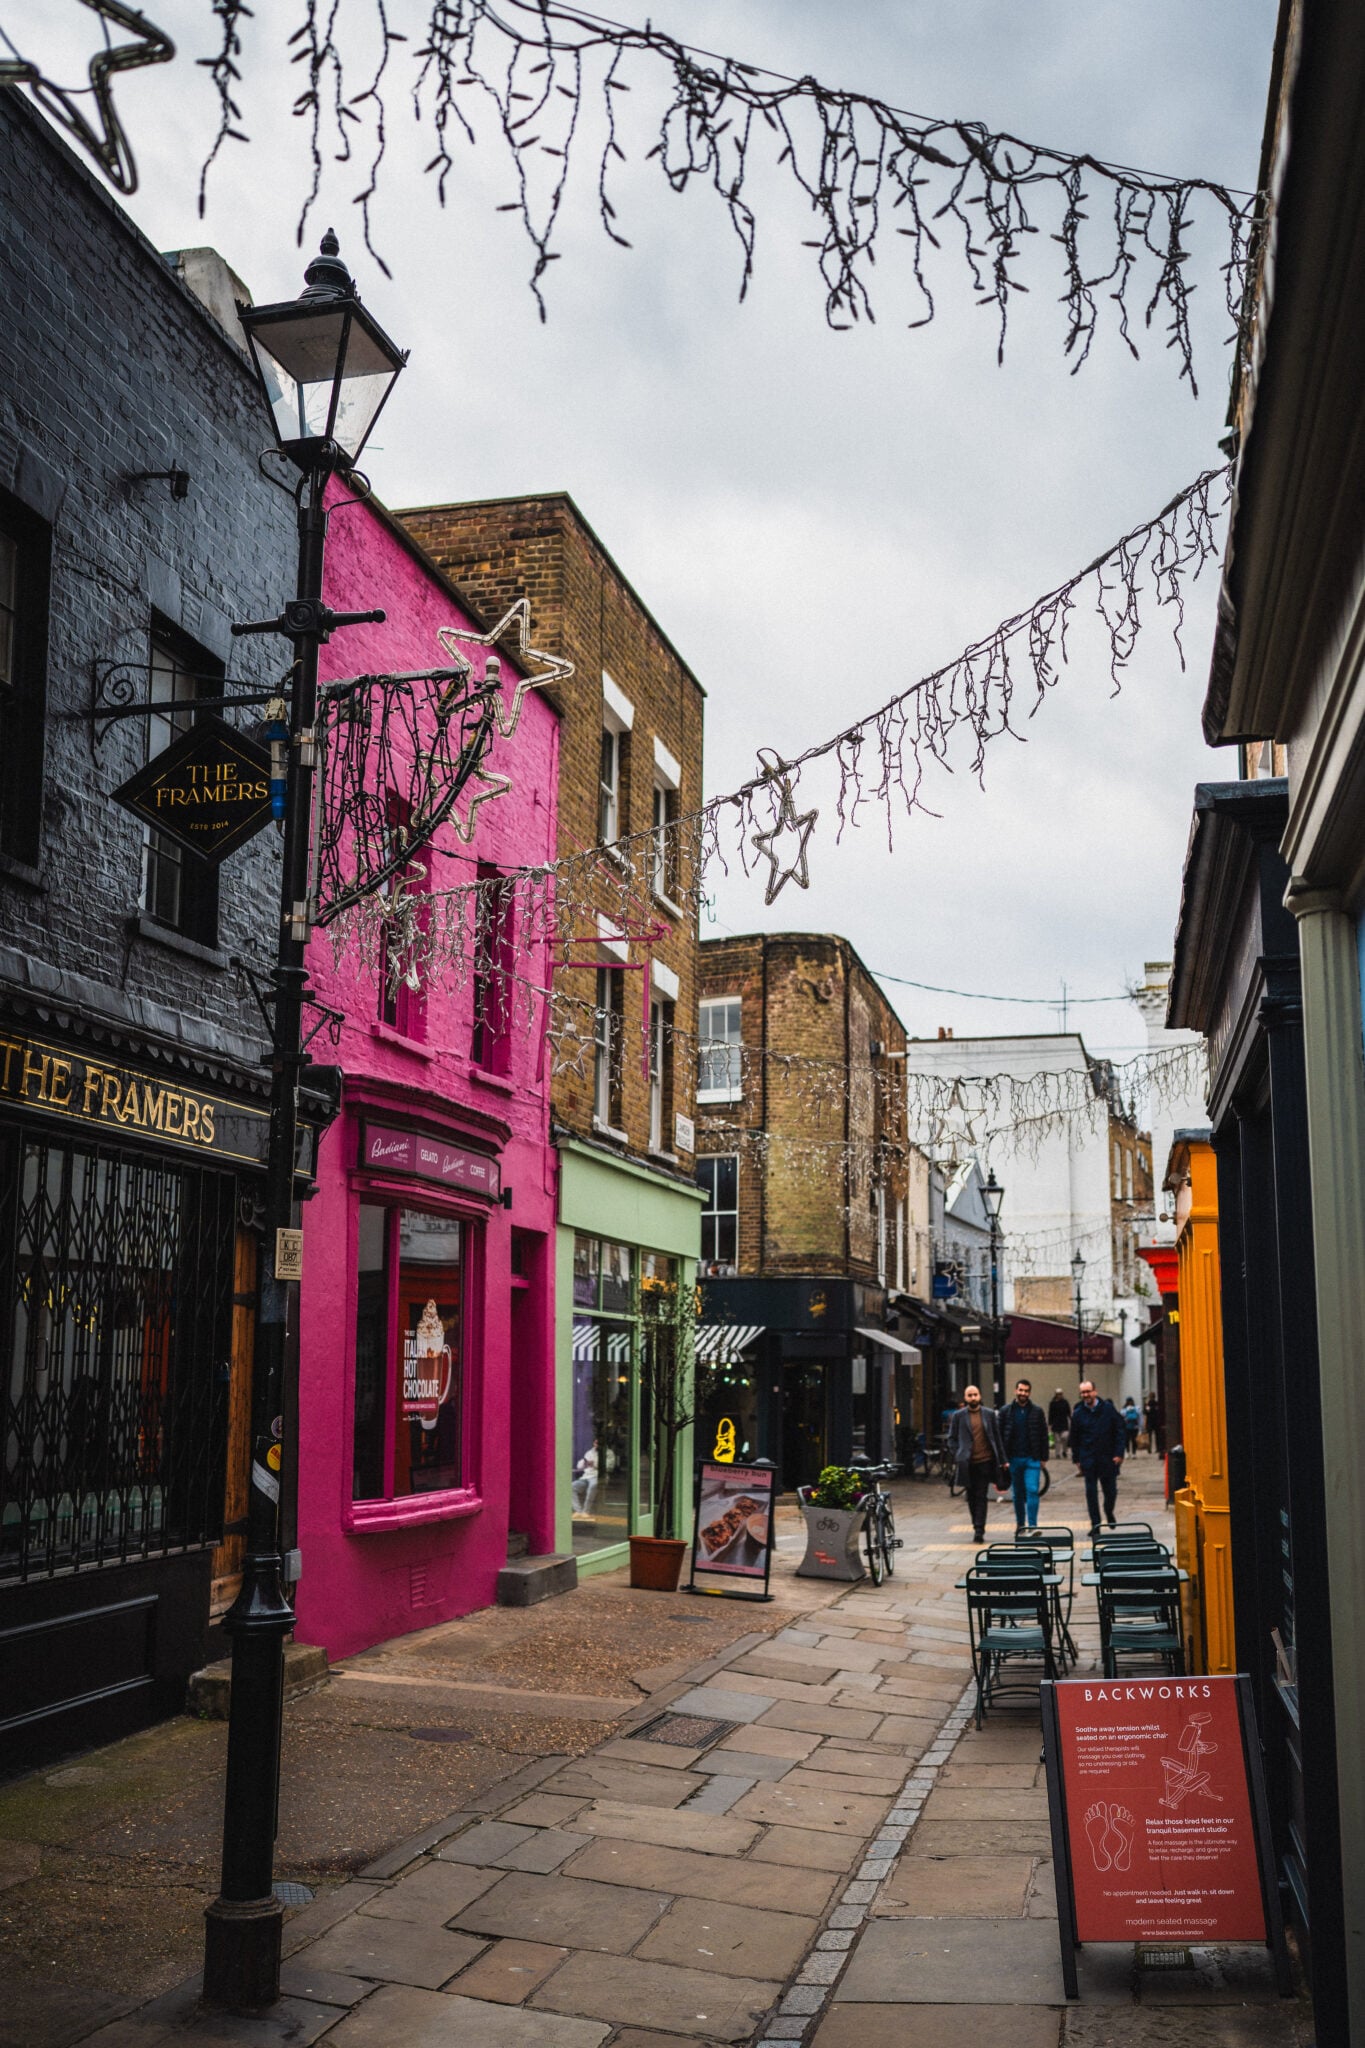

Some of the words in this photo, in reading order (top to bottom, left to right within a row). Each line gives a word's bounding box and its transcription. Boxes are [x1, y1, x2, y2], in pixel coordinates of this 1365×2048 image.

[186, 762, 238, 784] THE
[156, 781, 268, 808] FRAMERS
[211, 820, 229, 830] 2014
[0, 1040, 72, 1106] THE
[83, 1064, 215, 1144] FRAMERS
[371, 1137, 410, 1158] Badiani
[420, 1148, 438, 1164] GELATO
[470, 1164, 486, 1178] COFFEE
[404, 1340, 428, 1358] ITALIAN
[404, 1360, 418, 1378] HOT
[403, 1379, 440, 1399] CHOCOLATE
[1084, 1685, 1211, 1702] BACKWORKS
[1183, 1918, 1218, 1926] massage
